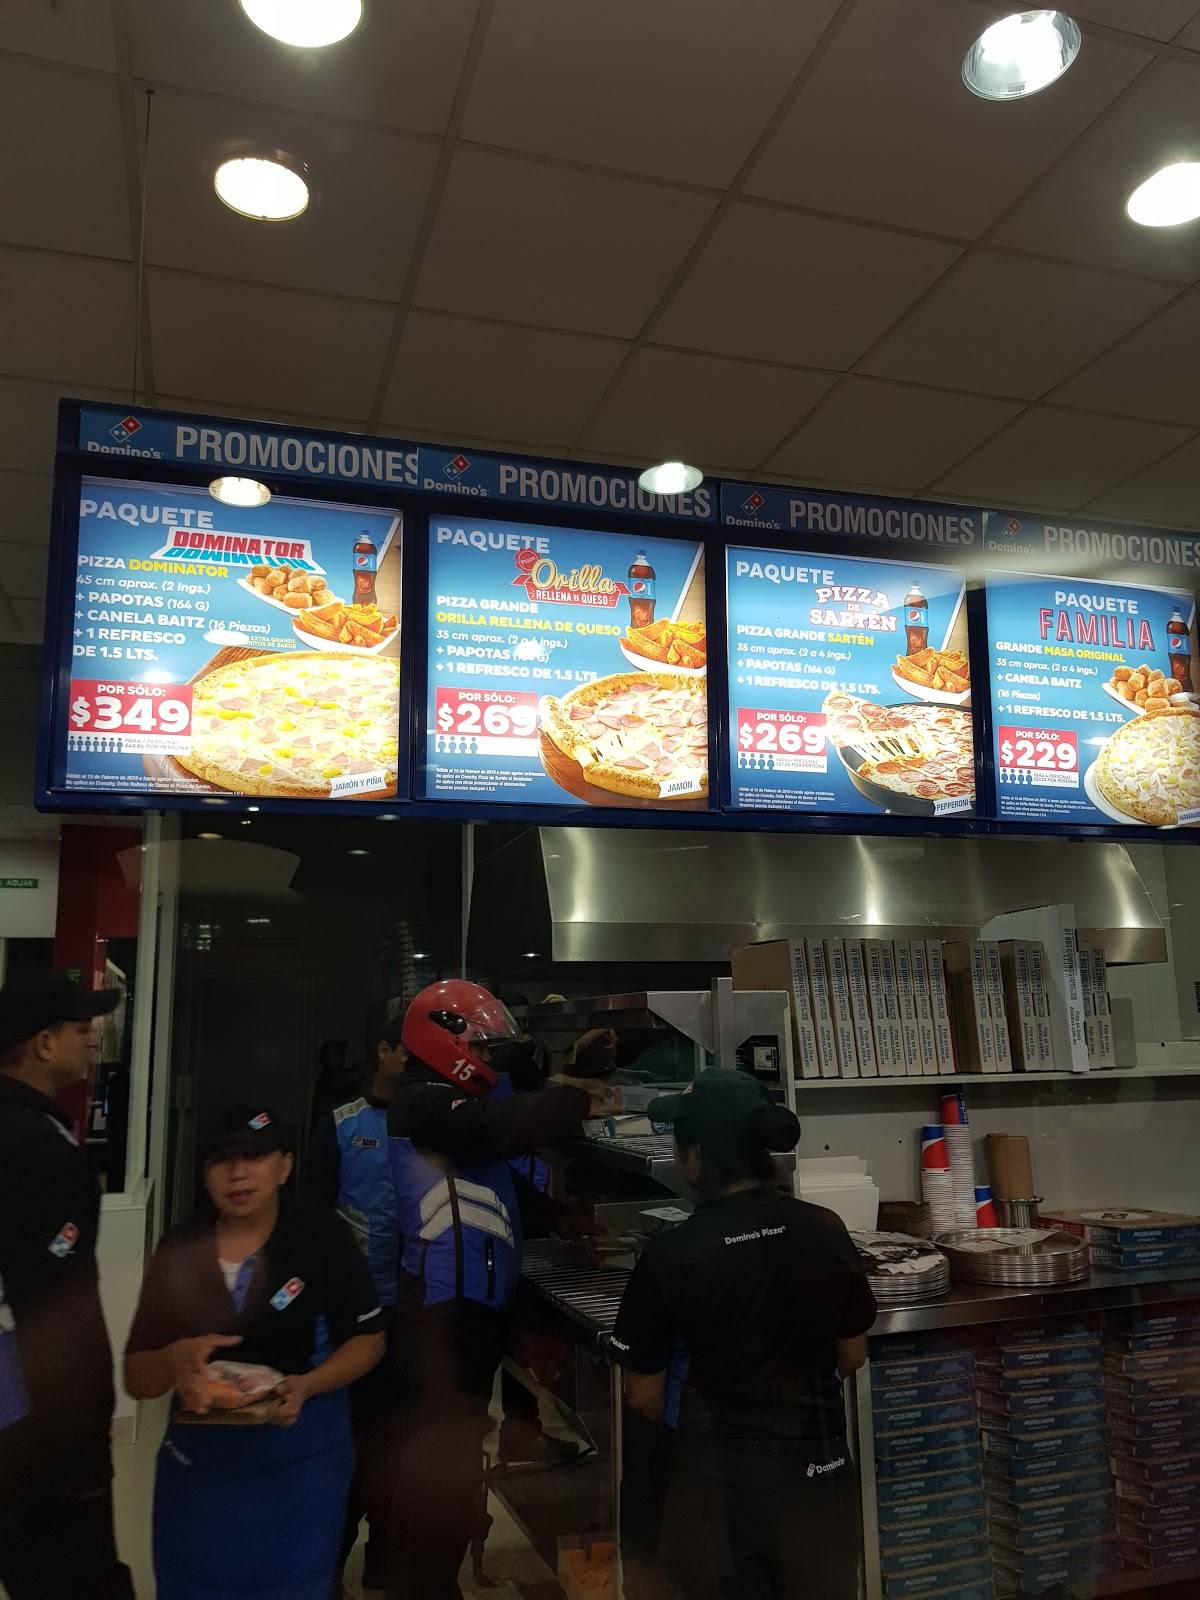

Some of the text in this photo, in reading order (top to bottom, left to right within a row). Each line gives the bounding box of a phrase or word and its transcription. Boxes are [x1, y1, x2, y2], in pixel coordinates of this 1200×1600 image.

[87, 441, 162, 460] Domino's
[176, 426, 419, 485] PROMOCIONES
[423, 478, 488, 497] Domino's
[500, 464, 711, 518] PROMOCIONES
[80, 499, 214, 529] PAQUETE
[726, 515, 781, 530] Domino's
[789, 500, 975, 545] PROMOCIONES
[173, 531, 305, 559] DOMINATOR
[436, 526, 550, 554] PAQUETE
[1043, 526, 1200, 567] PROMOCIONES
[77, 555, 229, 578] PIZZA DOMINATOR
[531, 558, 616, 594] Orilla
[736, 561, 835, 586] PAQUETE
[76, 574, 92, 584] 45
[95, 577, 115, 587] cm
[118, 578, 159, 591] aprox.
[162, 580, 174, 592] (2
[88, 591, 164, 608] PAPOTAS
[167, 598, 192, 611] (164
[195, 600, 210, 612] G)
[436, 595, 539, 614] PIZZA GRANDE
[535, 589, 572, 603] RELLENA
[581, 594, 608, 606] QUESO
[815, 585, 892, 610] PIZZA
[847, 602, 861, 612] DE
[1054, 590, 1140, 615] PAQUETE
[87, 609, 155, 626] CANELA
[158, 614, 205, 629] BAITZ
[208, 619, 226, 631] (16
[228, 621, 271, 635] Piezas)
[435, 611, 622, 637] ORILLA RELLENA DE QUESO
[809, 608, 899, 632] SARTÉN
[1039, 607, 1156, 652] FAMILIA
[86, 628, 94, 639] 1
[98, 628, 186, 645] REFRESCO
[436, 629, 449, 640] 35
[452, 632, 469, 641] cm
[471, 631, 505, 644] aprox.
[508, 634, 519, 645] (2
[736, 624, 875, 646] PIZZA GRANDE SARTÉN
[73, 644, 159, 662] DE 1.5 LTS.
[446, 645, 511, 661] PAPOTAS
[736, 642, 749, 652] 35
[750, 645, 766, 654] cm
[767, 646, 797, 657] aprox.
[799, 647, 809, 658] (2
[818, 649, 826, 658] 4
[995, 640, 1127, 663] GRANDE MASA ORIGINAL
[446, 662, 454, 673] 1
[456, 661, 531, 679] REFRESCO
[532, 668, 552, 680] DE
[554, 669, 573, 681] 1.5
[745, 658, 802, 673] PAPOTAS
[803, 663, 823, 674] (164
[824, 665, 836, 676] G)
[995, 658, 1007, 667] 35
[1008, 660, 1022, 668] cm
[1023, 660, 1050, 672] aprox.
[1051, 662, 1060, 673] (2
[1068, 665, 1075, 673] 4
[97, 684, 167, 697] POR SÓLO:
[746, 675, 753, 686] 1
[754, 675, 820, 691] REFRESCO
[821, 681, 839, 692] DE
[840, 682, 858, 694] 1.5
[858, 684, 882, 696] LTS.
[1004, 673, 1051, 686] CANELA
[1051, 677, 1083, 689] BAITZ
[458, 691, 516, 704] POR SÓLO:
[997, 690, 1010, 699] (16
[70, 696, 190, 733] $349
[437, 702, 537, 736] $269
[756, 712, 807, 724] POR SÓLO:
[1006, 704, 1012, 714] 1
[1013, 704, 1072, 719] REFRESCO
[1073, 710, 1088, 720] DE
[1089, 711, 1104, 722] 1.5
[1105, 712, 1127, 724] LTS.
[739, 722, 825, 754] $269
[1015, 730, 1061, 741] POR SÓLO:
[1000, 739, 1078, 770] $229
[333, 776, 382, 791] JAMÓN Y PIÑA
[667, 780, 693, 793] JAMÓN
[936, 799, 970, 811] PEPPERONI
[451, 1058, 475, 1081] 15
[724, 1230, 761, 1245] Domino's
